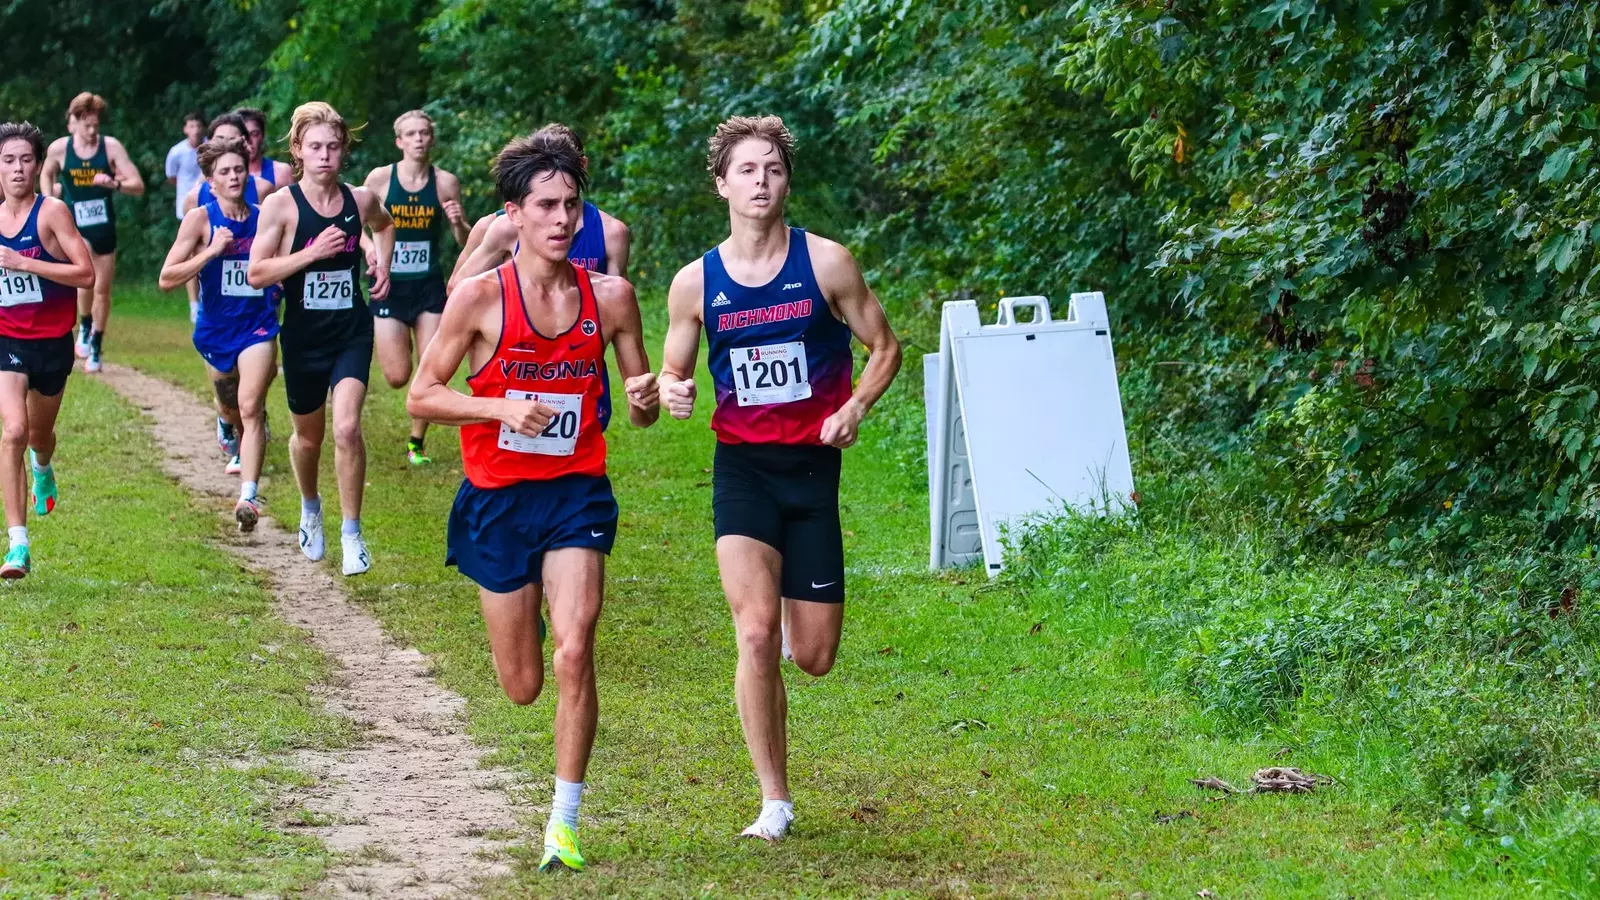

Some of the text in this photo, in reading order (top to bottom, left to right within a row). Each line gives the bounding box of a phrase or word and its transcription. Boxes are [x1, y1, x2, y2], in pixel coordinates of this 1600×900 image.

[391, 204, 434, 217] WILLIAM
[394, 249, 427, 264] 1378
[308, 280, 351, 298] 1276
[717, 299, 812, 332] RICHMOND
[500, 359, 598, 380] VIRGINIA
[736, 357, 802, 389] 1201
